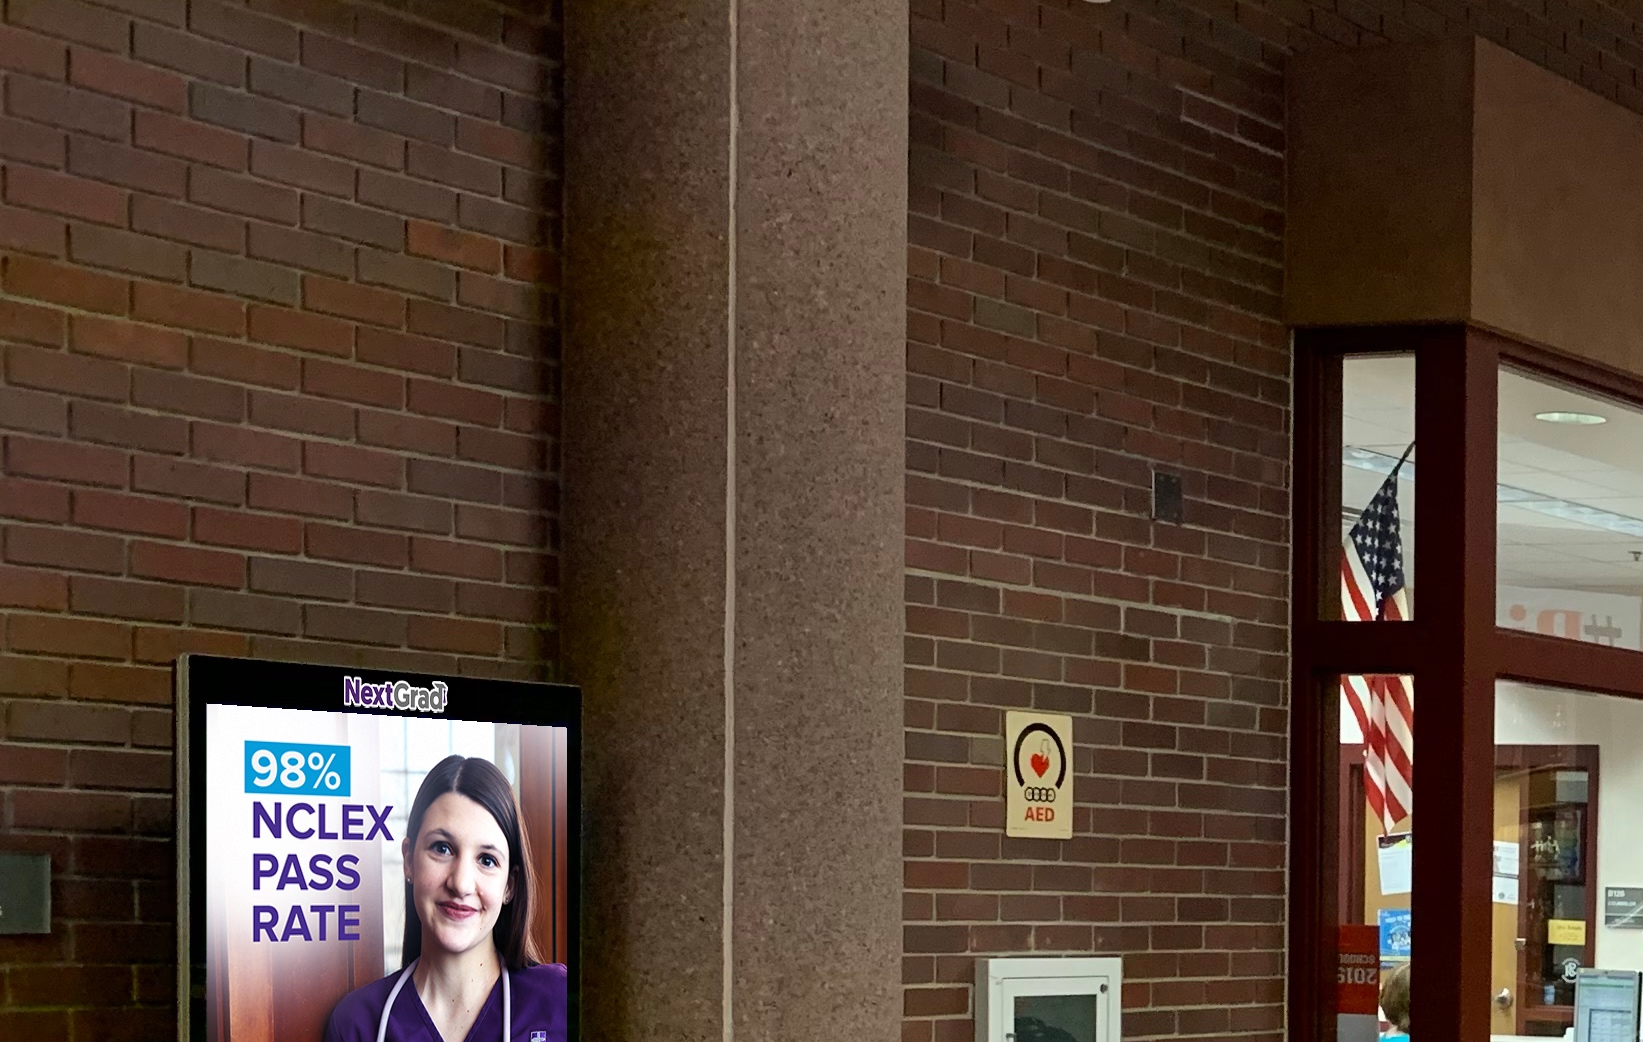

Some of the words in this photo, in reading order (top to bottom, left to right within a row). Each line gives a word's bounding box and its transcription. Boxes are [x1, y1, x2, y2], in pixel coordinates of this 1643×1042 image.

[344, 676, 448, 712] NextGrad
[251, 749, 341, 790] 98%
[253, 801, 394, 841] NCLEX
[1025, 806, 1055, 822] AED
[253, 853, 361, 891] PASS
[253, 904, 360, 942] RATE
